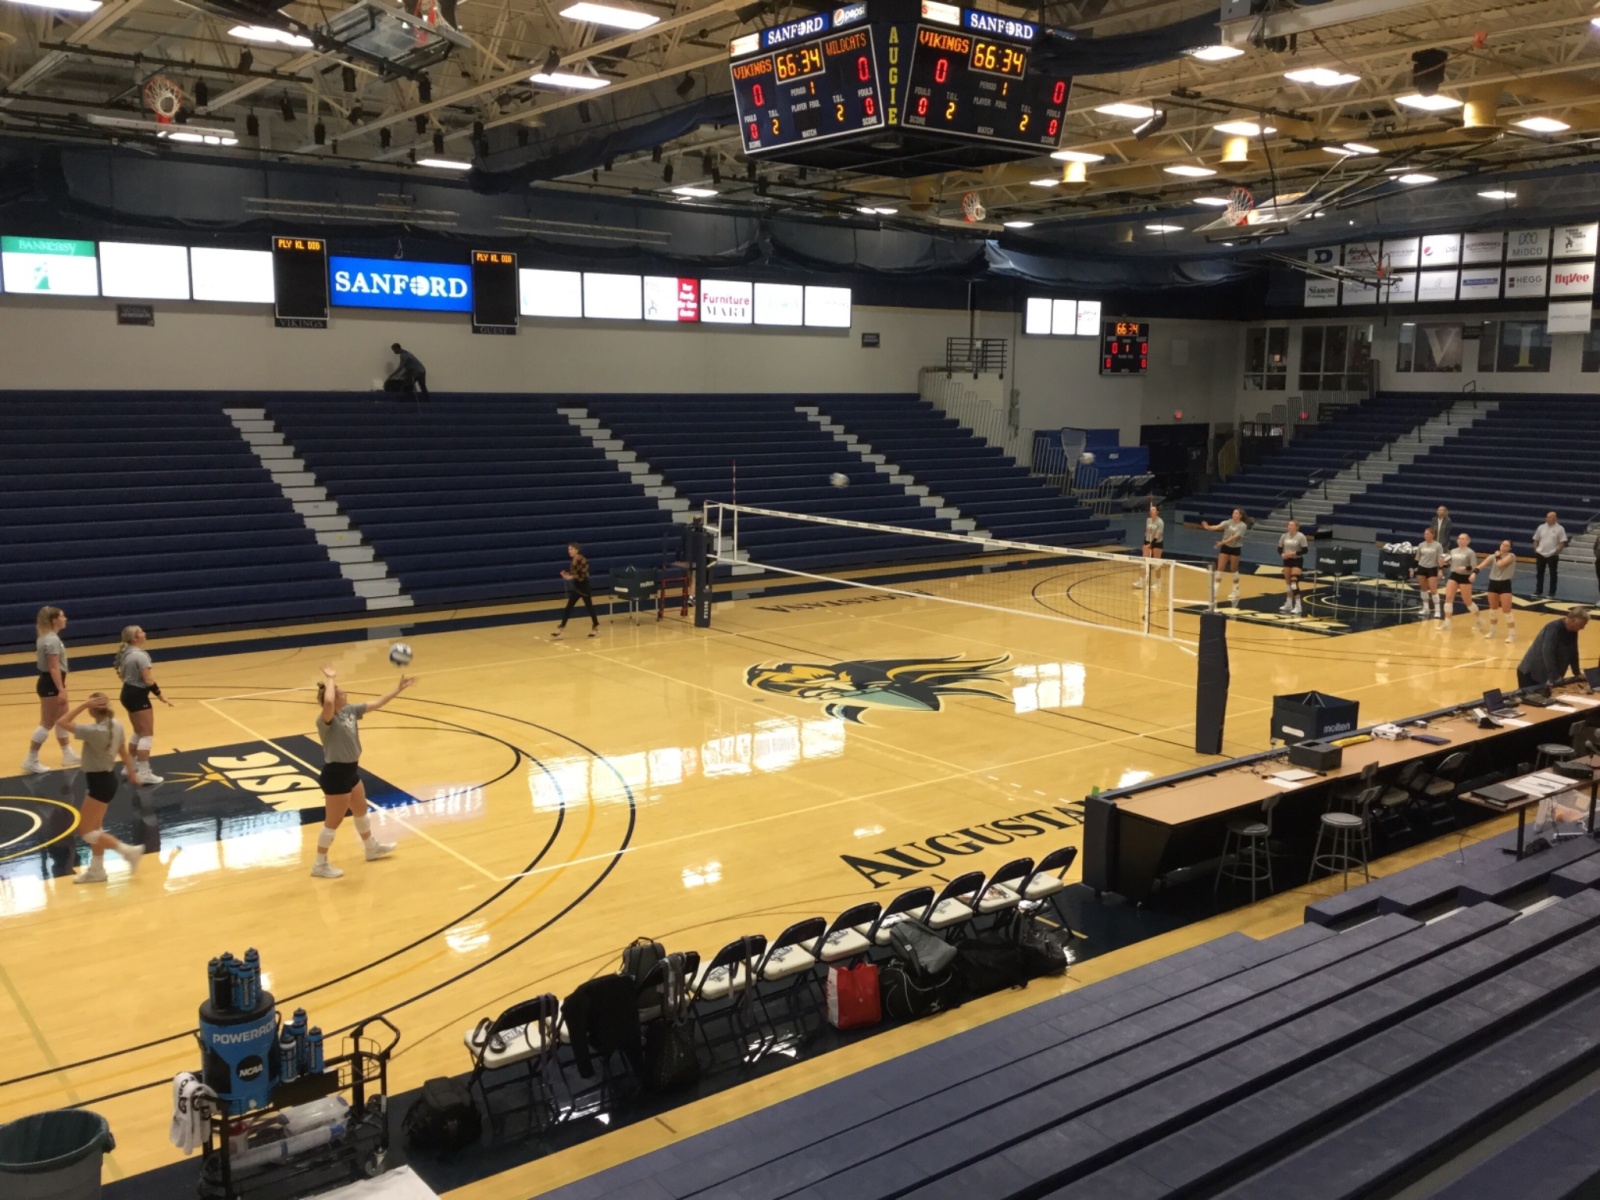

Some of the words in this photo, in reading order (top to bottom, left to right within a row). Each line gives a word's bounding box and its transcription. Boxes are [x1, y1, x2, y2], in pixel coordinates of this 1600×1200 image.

[768, 17, 824, 44] SANFORD
[971, 13, 1033, 40] SANFORD
[919, 30, 970, 54] VIKINGS
[733, 59, 772, 80] VIKINGS
[858, 56, 870, 81] 0
[888, 26, 899, 125] AUGIE
[935, 59, 948, 82] 0
[752, 84, 764, 106] 0
[1053, 81, 1066, 104] 0
[836, 104, 844, 122] 2
[866, 97, 874, 116] 0
[918, 97, 928, 115] 0
[946, 102, 956, 120] 2
[750, 124, 758, 140] 0
[772, 118, 779, 135] 2
[1019, 114, 1028, 132] 2
[1048, 119, 1058, 136] 0
[1512, 247, 1543, 256] MIDCO
[335, 271, 468, 298] SANFORD
[703, 292, 750, 306] Furniture
[1323, 722, 1351, 734] molten
[840, 800, 1086, 889] AUGUSTA
[238, 1064, 264, 1078] NCAA
